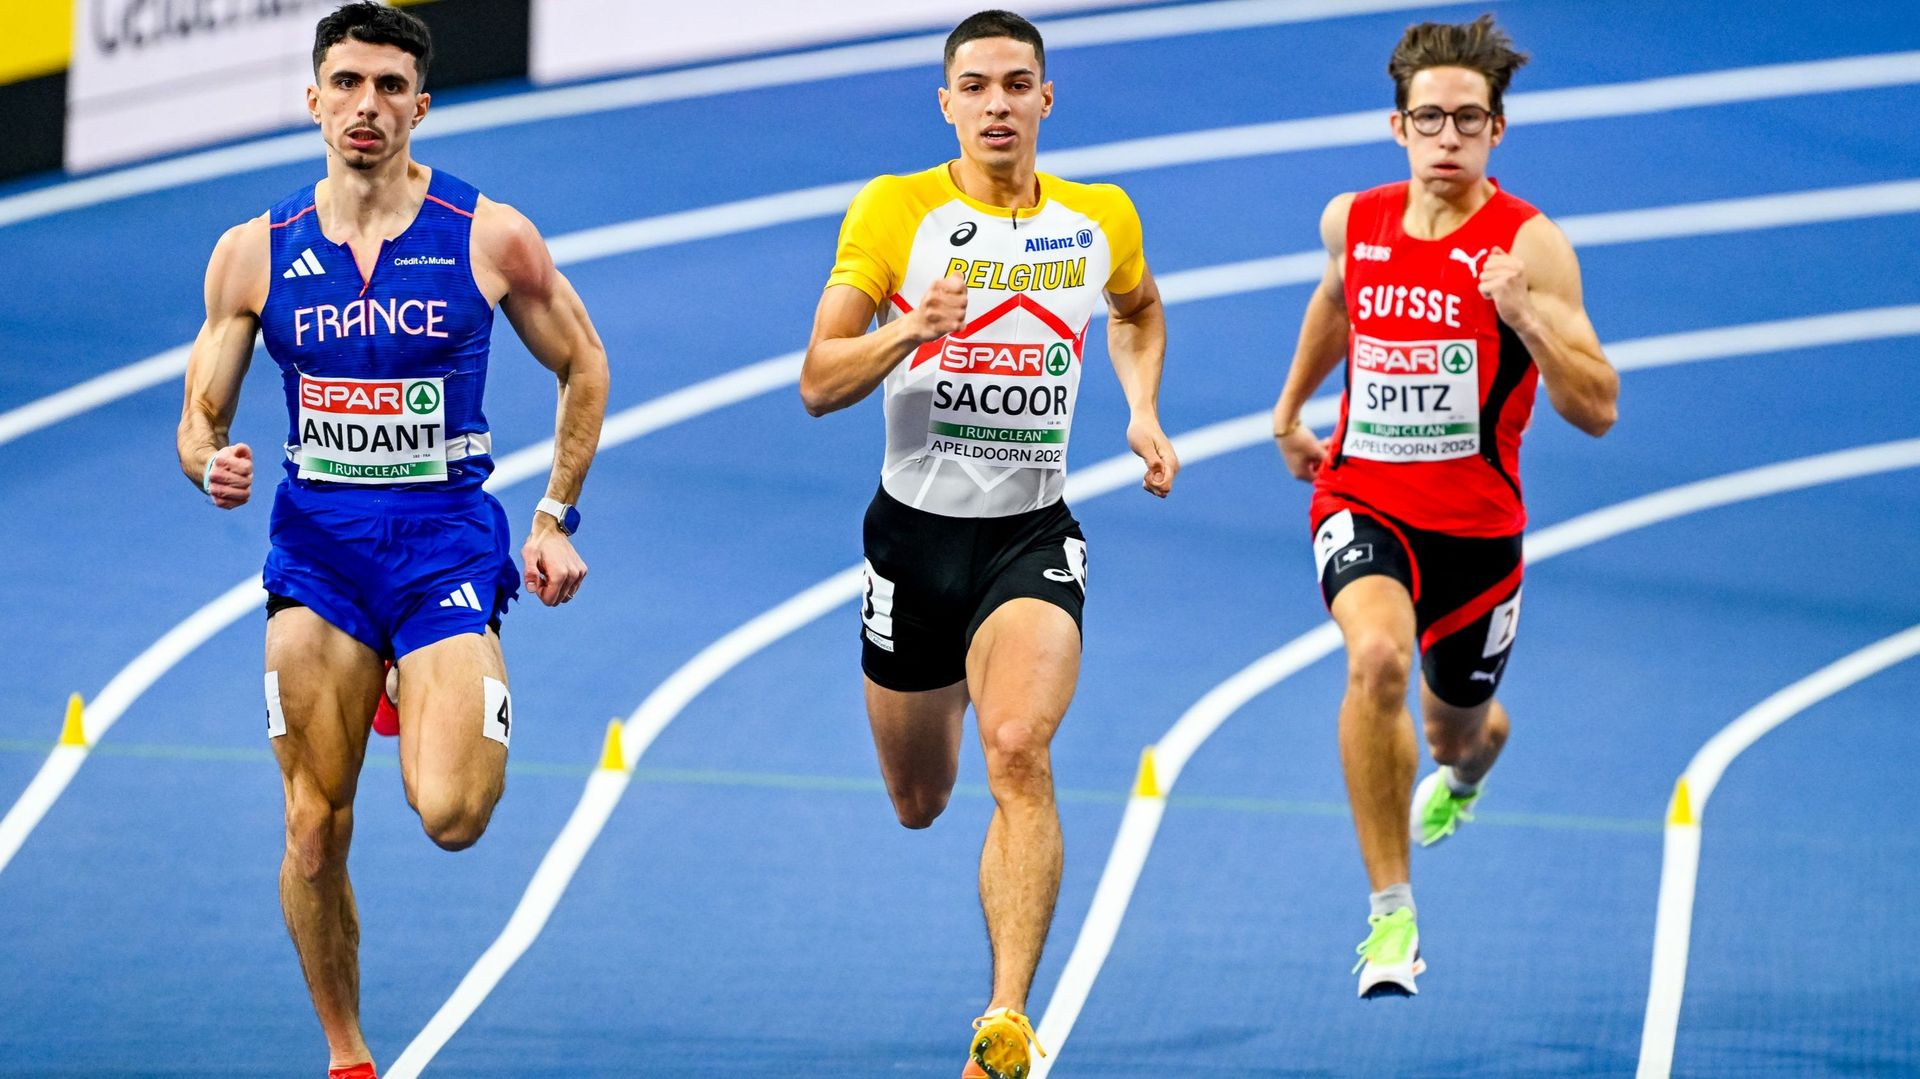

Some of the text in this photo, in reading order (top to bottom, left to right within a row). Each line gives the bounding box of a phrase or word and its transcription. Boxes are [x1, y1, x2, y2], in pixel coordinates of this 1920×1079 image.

[1024, 236, 1075, 253] Allianz
[394, 256, 456, 266] Crédit Mutuel
[944, 256, 1087, 292] BELGIUM
[294, 298, 449, 346] FRANCE
[943, 345, 1042, 372] SPAR
[1358, 343, 1436, 372] SPAR
[302, 383, 400, 411] SPAR
[933, 380, 1068, 416] SACOOR
[1367, 383, 1452, 412] SPITZ
[302, 418, 441, 453] ANDANT
[966, 428, 996, 440] RUN
[1350, 439, 1476, 456] APELDOORN 2025
[931, 440, 1063, 463] APELDOORN 202
[335, 464, 362, 476] RUN
[497, 696, 509, 737] 4
